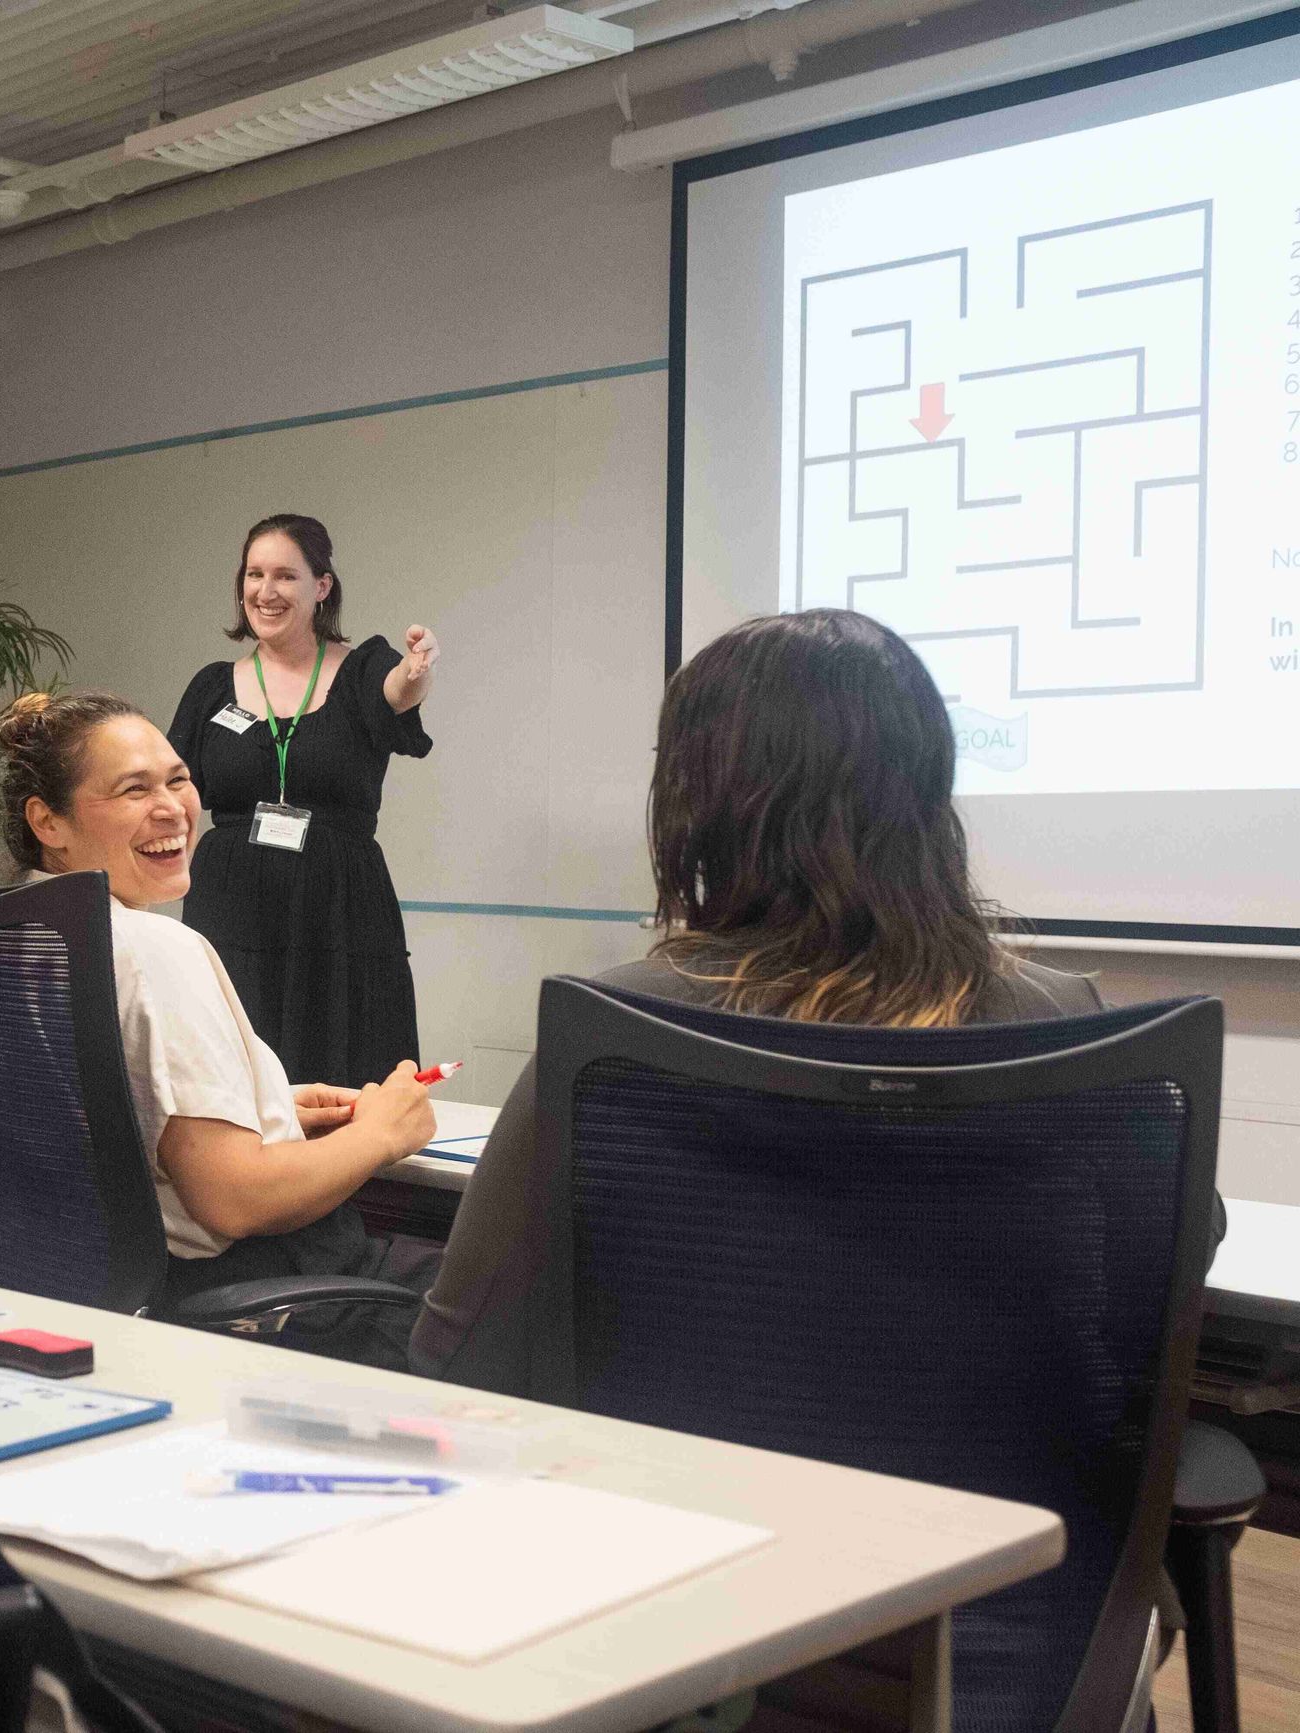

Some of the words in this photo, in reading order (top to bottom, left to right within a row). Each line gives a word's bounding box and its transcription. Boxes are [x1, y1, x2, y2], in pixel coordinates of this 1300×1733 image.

[1290, 240, 1300, 260] 2
[1289, 275, 1300, 297] 3
[1286, 308, 1300, 330] 4
[1286, 342, 1300, 365] 5
[1284, 373, 1300, 395] 6
[1287, 410, 1300, 433] 7
[1283, 441, 1298, 463] 8
[1270, 617, 1293, 638] In
[956, 728, 1016, 750] GOAL
